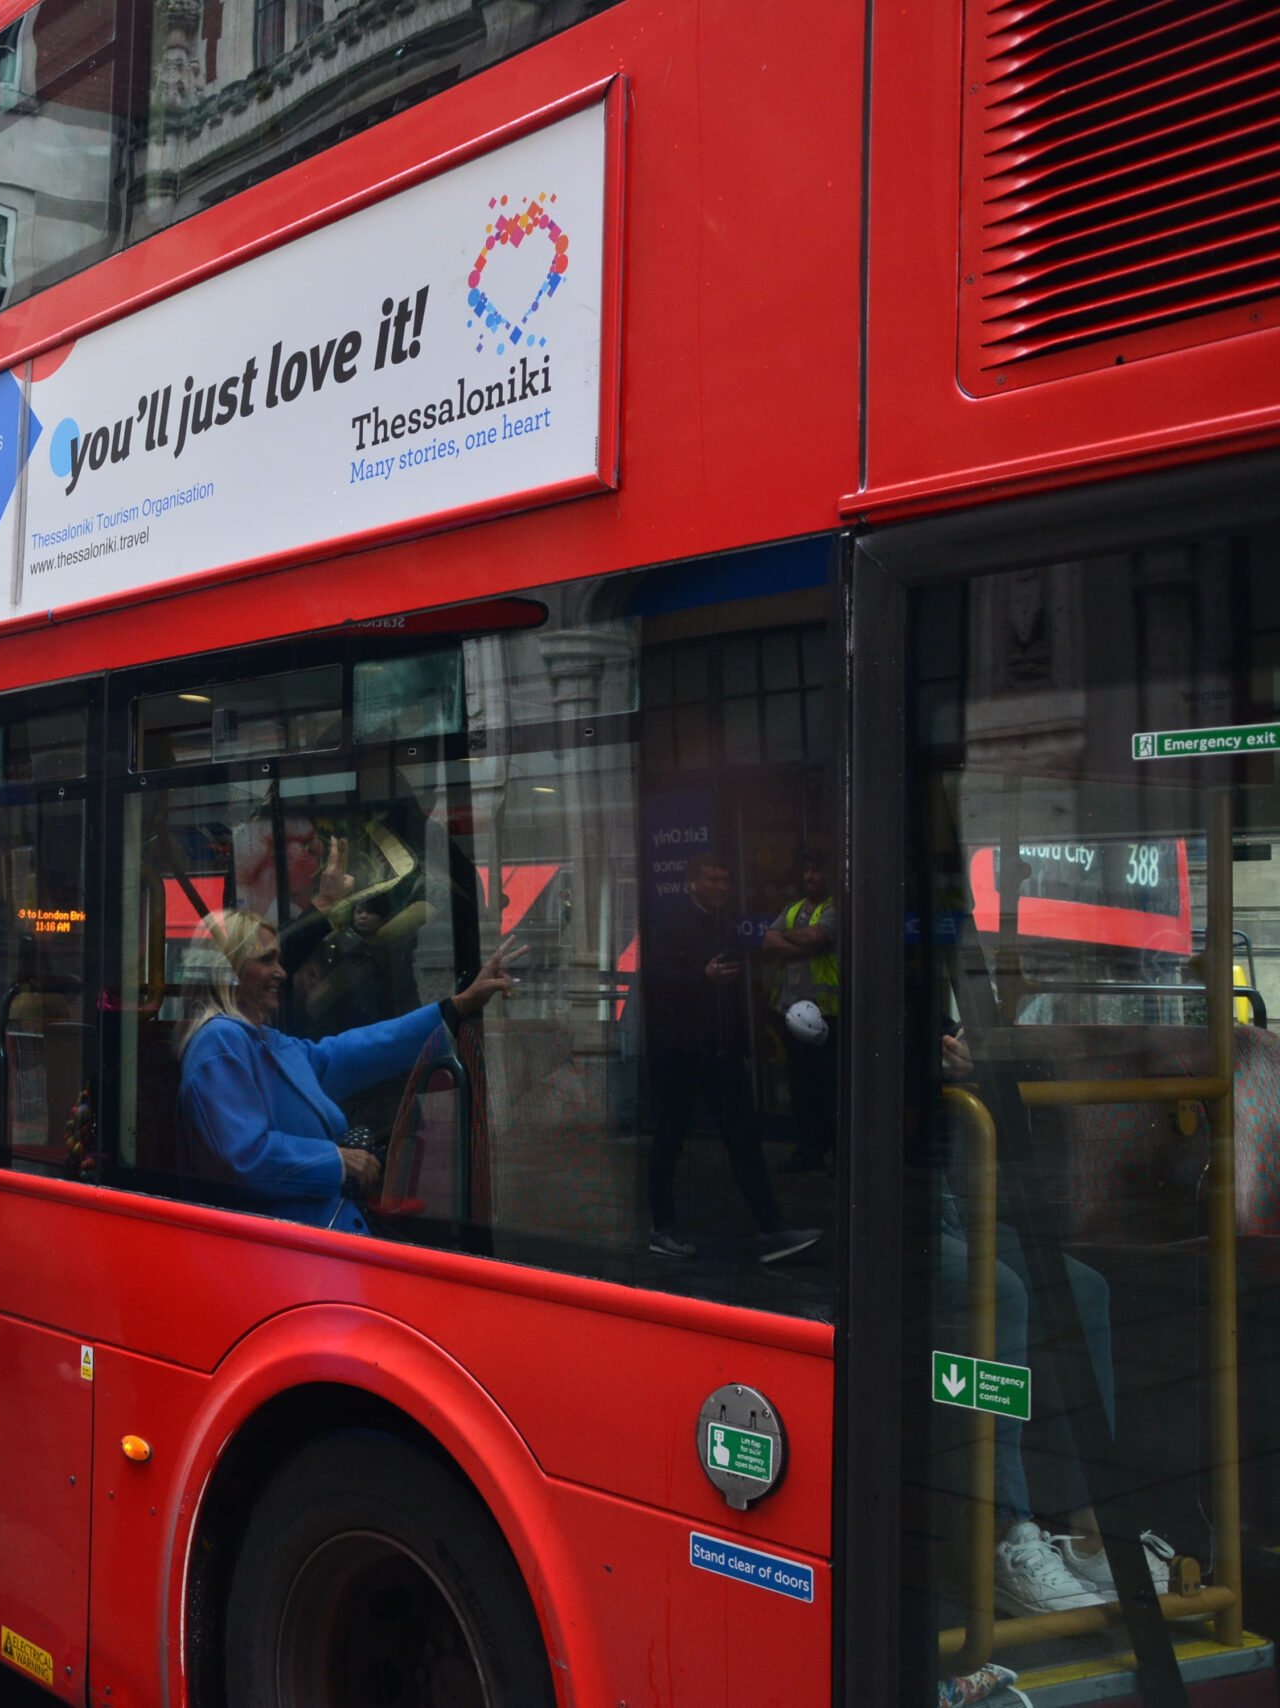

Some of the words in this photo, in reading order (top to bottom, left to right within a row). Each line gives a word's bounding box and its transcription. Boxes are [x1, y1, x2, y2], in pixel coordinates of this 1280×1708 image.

[174, 355, 259, 459] just
[265, 329, 362, 409] love
[374, 284, 430, 371] it!
[351, 354, 552, 452] Thessaloniki
[349, 457, 395, 485] Many
[398, 438, 460, 471] stories,
[465, 426, 497, 451] one
[501, 407, 551, 440] heart
[32, 516, 94, 550] Thessaloniki
[97, 504, 139, 531] Tourism
[142, 482, 215, 518] Organisation
[30, 526, 150, 575] www.thessaloniki.travel
[1164, 736, 1242, 752] Emergency
[1247, 731, 1276, 745] exit
[1126, 843, 1160, 888] 388
[27, 909, 36, 919] to
[38, 909, 69, 920] London
[57, 922, 70, 932] AM
[979, 1371, 1025, 1389] Emergency
[979, 1382, 999, 1393] door
[979, 1393, 1011, 1406] control
[735, 1461, 748, 1469] open
[737, 1453, 765, 1466] emergency
[694, 1544, 725, 1565] Stand
[728, 1557, 756, 1575] clear
[758, 1566, 772, 1580] of
[774, 1570, 810, 1592] doors
[12, 1635, 52, 1670] ELECTRICAL
[16, 1650, 49, 1682] WARNING
